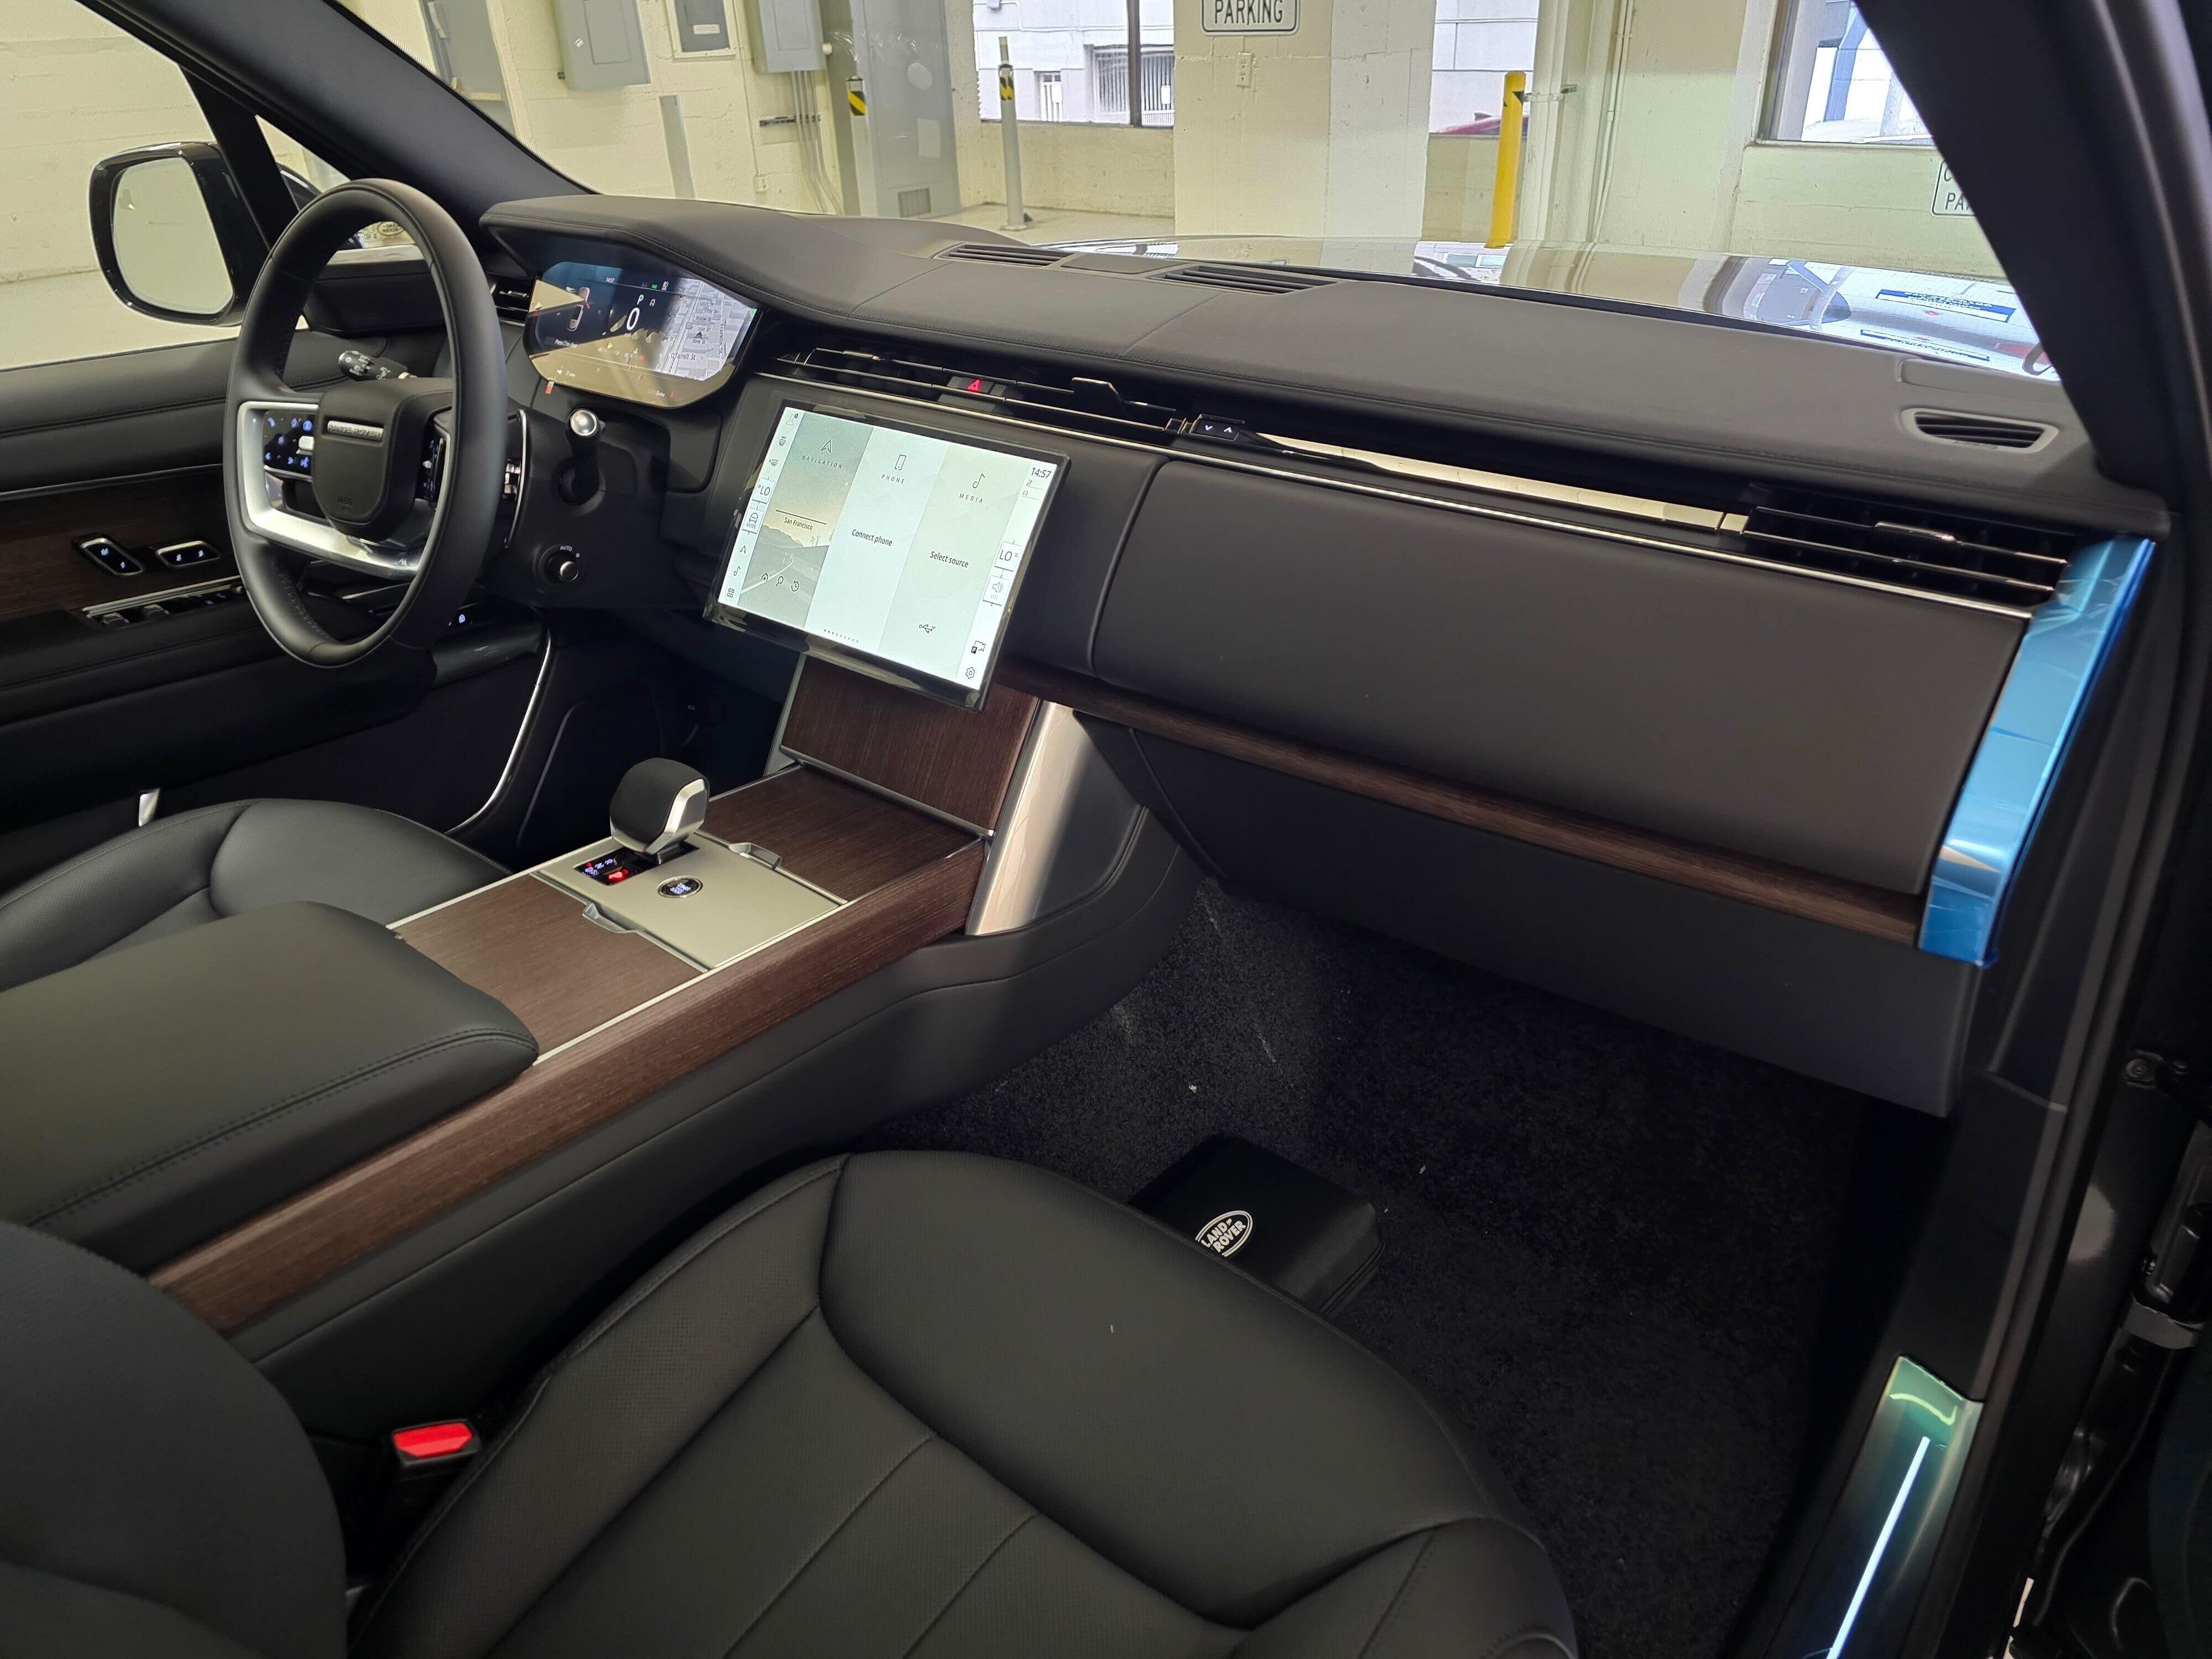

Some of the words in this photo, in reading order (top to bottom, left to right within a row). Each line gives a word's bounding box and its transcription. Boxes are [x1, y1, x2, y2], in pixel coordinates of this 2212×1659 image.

[1214, 0, 1283, 24] PARKING
[1945, 192, 1969, 211] PA
[637, 294, 644, 306] P
[626, 307, 640, 331] 0
[802, 455, 843, 469] NAVIGATION
[881, 473, 905, 484] PHONE
[1031, 467, 1052, 479] 14:57
[760, 485, 770, 496] LO
[959, 493, 983, 504] MEDIA
[784, 517, 792, 525] San
[793, 519, 813, 531] Francisco
[852, 529, 874, 541] Connect
[874, 535, 893, 547] phone
[930, 551, 948, 562] Select
[948, 557, 969, 568] source
[999, 549, 1013, 561] LO
[1201, 1222, 1228, 1248] LAND
[1213, 1220, 1246, 1253] ROVER
